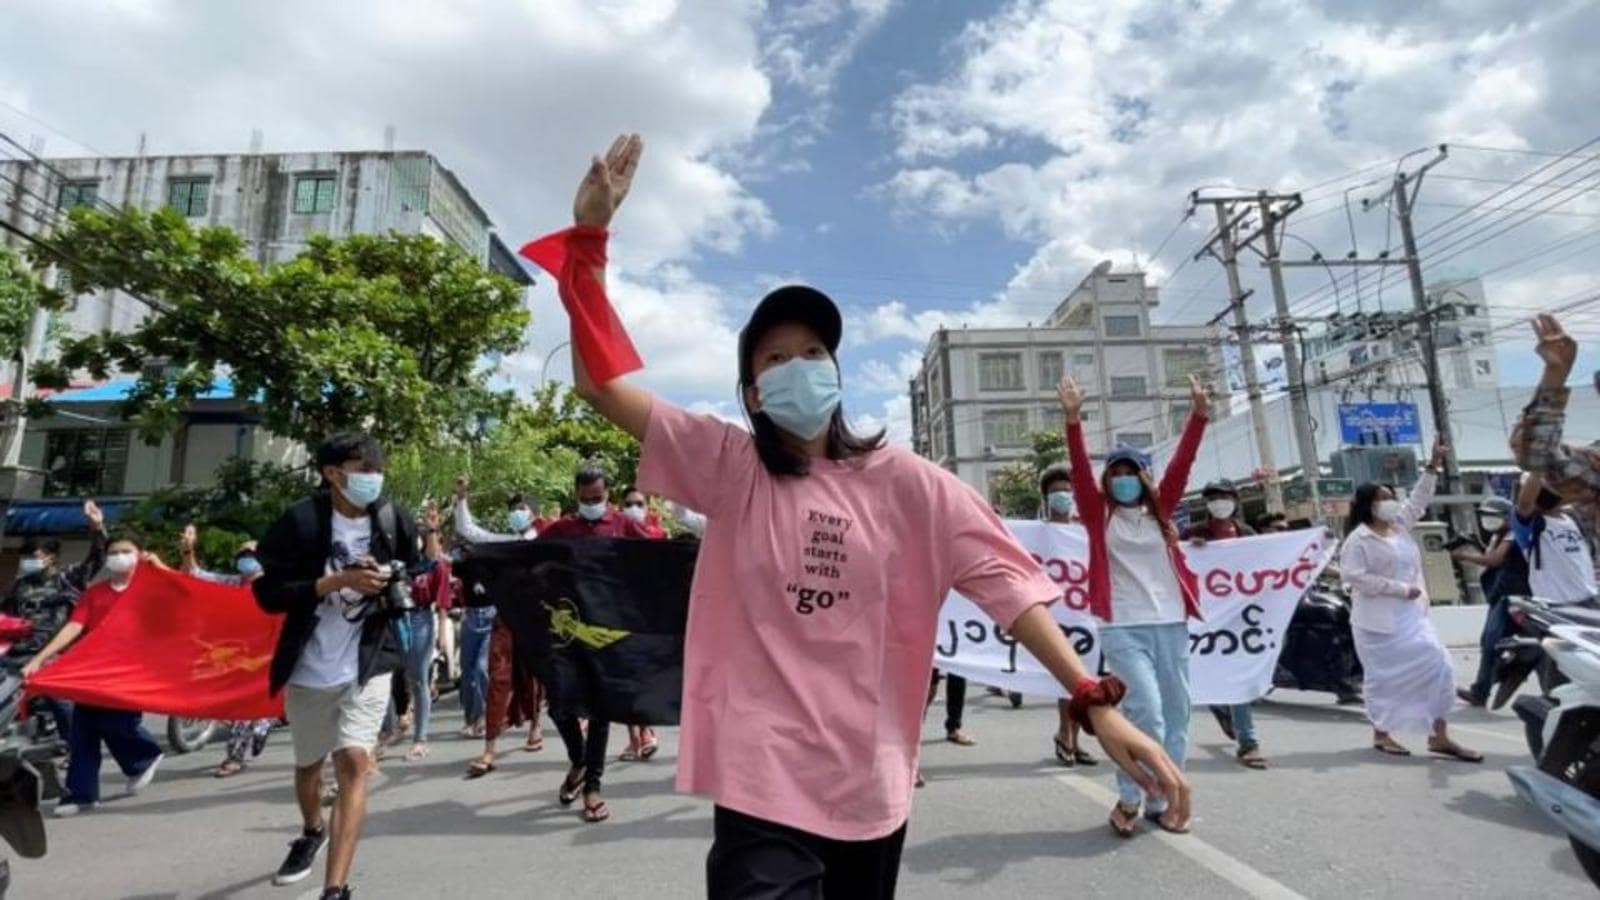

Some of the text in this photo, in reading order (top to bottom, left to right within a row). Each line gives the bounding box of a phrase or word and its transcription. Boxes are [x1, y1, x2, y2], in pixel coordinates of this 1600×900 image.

[808, 508, 853, 532] Every
[811, 530, 845, 546] goal
[804, 546, 848, 563] starts
[804, 563, 840, 579] with
